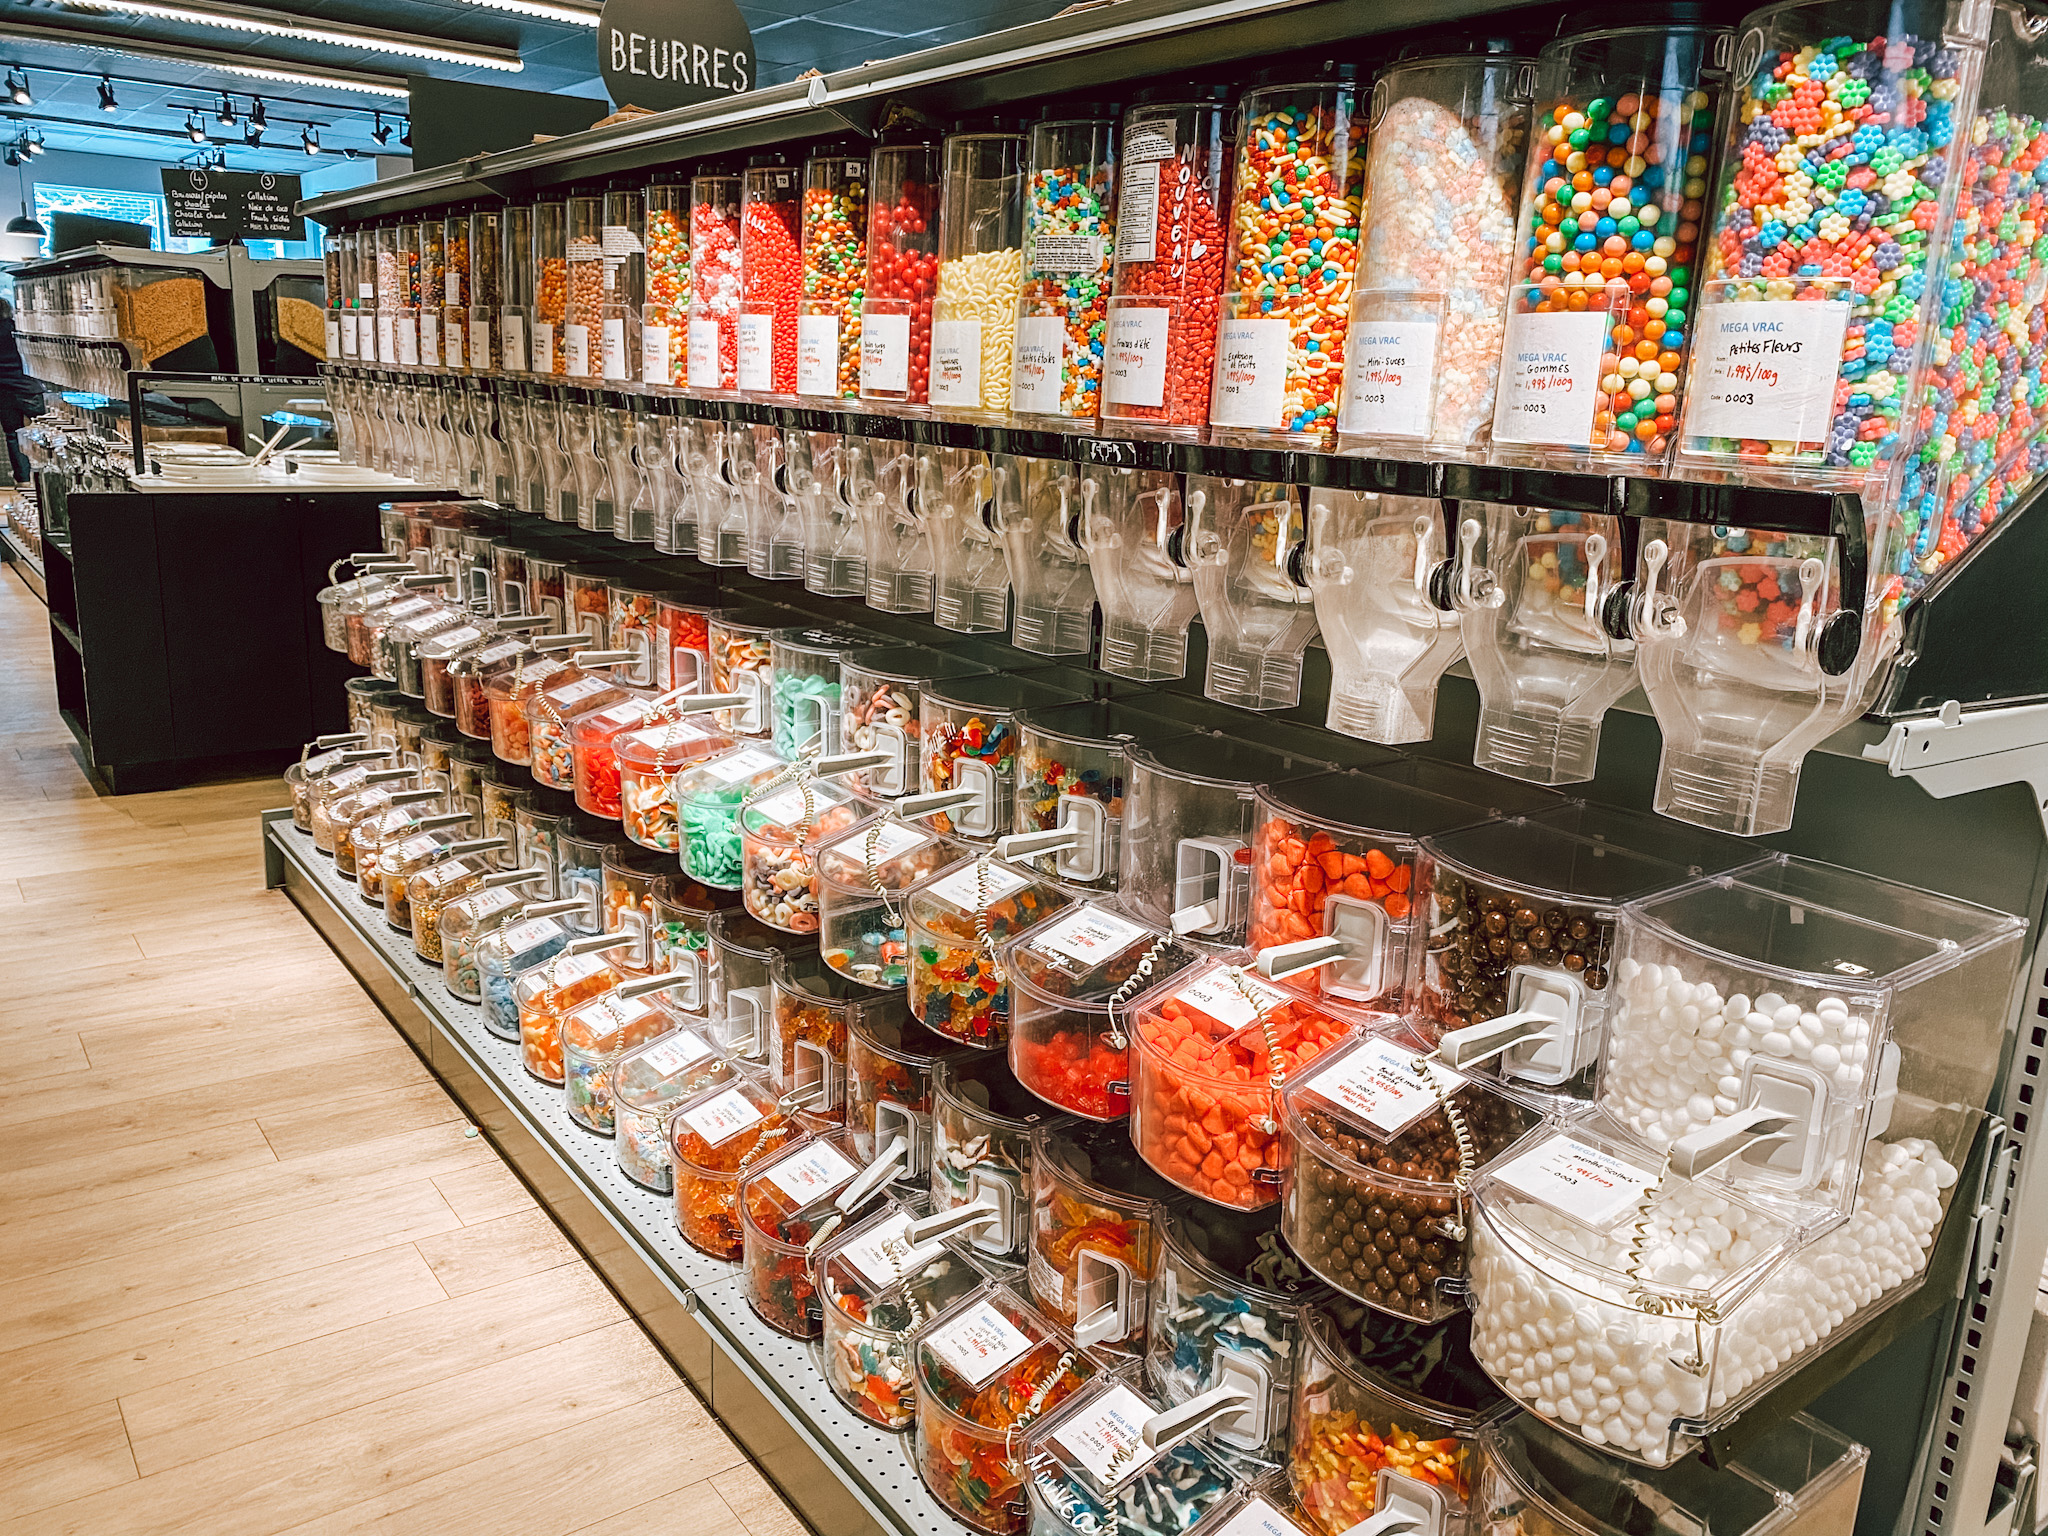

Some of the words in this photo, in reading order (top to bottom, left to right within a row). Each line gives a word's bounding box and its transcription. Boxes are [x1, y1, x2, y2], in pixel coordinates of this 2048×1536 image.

[611, 28, 748, 93] BEURRES
[1721, 322, 1749, 333] MEGA
[1752, 321, 1784, 332] VRAC
[1223, 332, 1236, 340] MEGA
[1237, 331, 1255, 339] VRAC
[1359, 336, 1377, 345] MEGA
[1379, 336, 1401, 344] VRAC
[1763, 339, 1803, 354] Fleurs
[1517, 353, 1540, 362] MEGA
[1542, 353, 1568, 362] VRAC
[1226, 386, 1239, 394] 0003
[1364, 394, 1385, 404] 0003
[1725, 393, 1754, 405] 0003
[1523, 403, 1546, 414] 0003
[1188, 989, 1213, 1003] 0003
[1378, 1054, 1401, 1068] MEGA
[1569, 1143, 1596, 1158] MEGA
[1598, 1154, 1624, 1168] VRAC
[1554, 1172, 1578, 1185] 0003
[981, 1315, 995, 1329] MEGA
[994, 1326, 1007, 1338] VRAC
[1108, 1409, 1125, 1425] MEGA
[1124, 1423, 1140, 1437] VRAC
[1090, 1437, 1105, 1451] 0003
